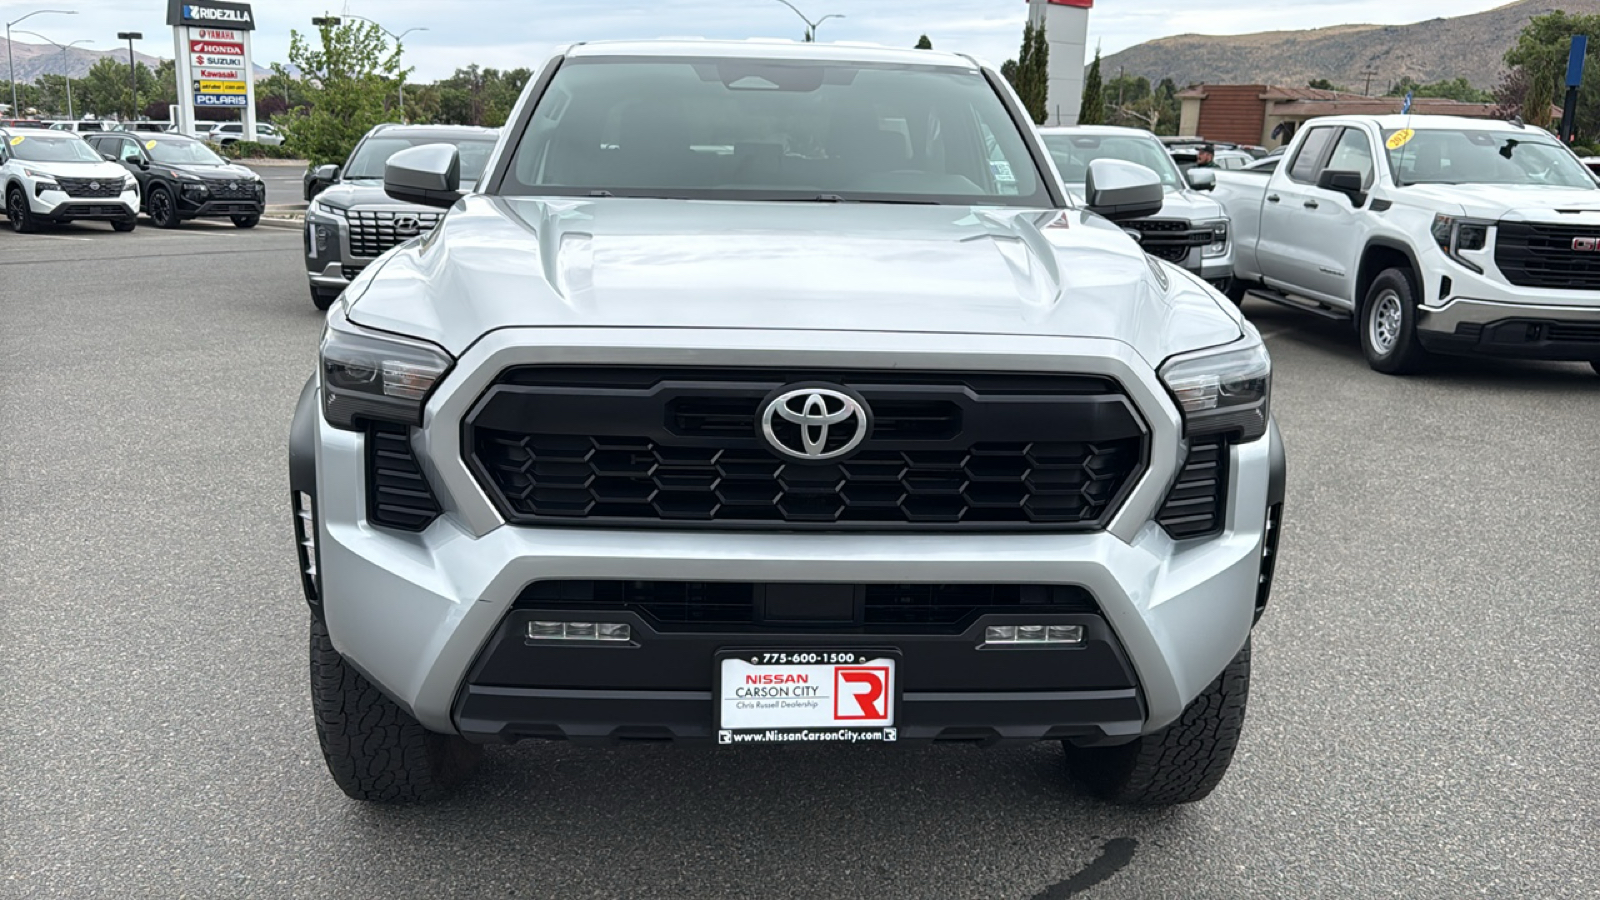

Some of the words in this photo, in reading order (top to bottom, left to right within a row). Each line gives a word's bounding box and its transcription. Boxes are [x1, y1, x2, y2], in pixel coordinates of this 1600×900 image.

[200, 8, 250, 22] RIDEZILLA
[207, 30, 235, 40] YAMAHA
[204, 44, 241, 54] HONDA
[207, 57, 240, 66] SUZUKI
[201, 70, 238, 79] Kawasaki
[197, 95, 246, 104] POLARIS
[763, 653, 854, 663] 775-600-1500
[746, 674, 808, 684] NISSAN
[735, 687, 791, 698] CARSON
[792, 686, 819, 697] CITY
[736, 701, 754, 709] Chris
[781, 700, 818, 709] Dealership
[734, 730, 882, 743] www.NissanCarsonCity.com
